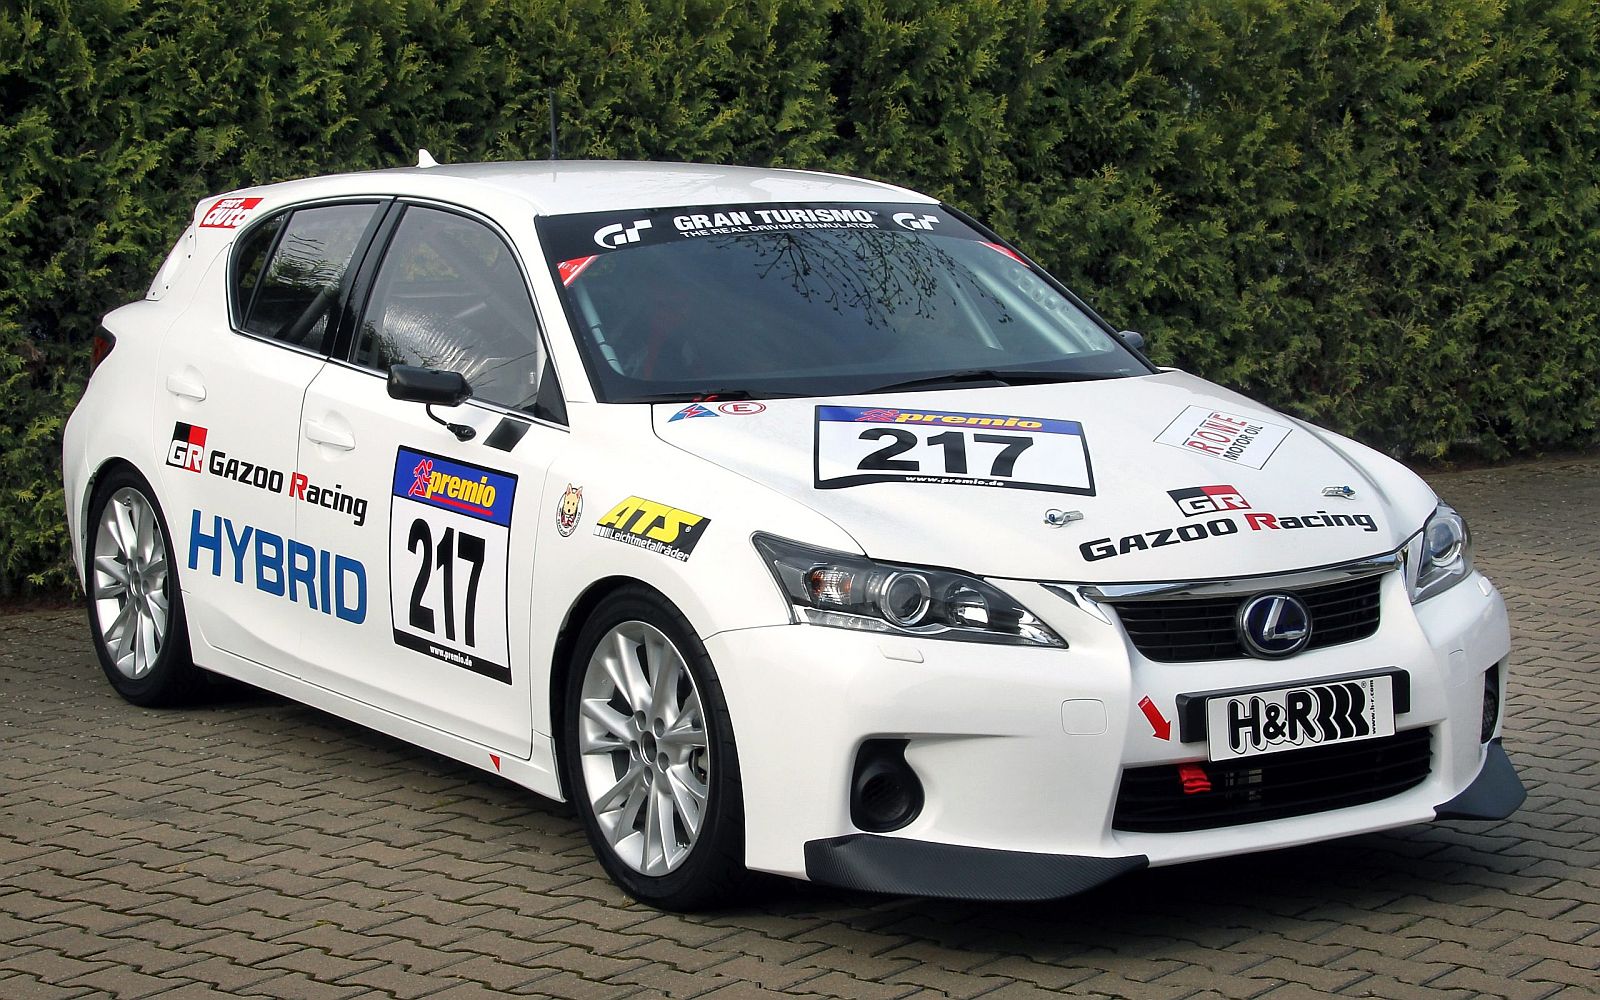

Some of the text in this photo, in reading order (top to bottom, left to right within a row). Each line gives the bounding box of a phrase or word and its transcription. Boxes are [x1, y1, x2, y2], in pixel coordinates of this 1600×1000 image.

[203, 207, 252, 226] auto
[673, 208, 873, 232] GRAN TURISMO
[679, 221, 880, 238] THE REAL DRIVING SIMULATOR
[895, 412, 1043, 429] premio
[1187, 413, 1247, 456] ROWE
[167, 439, 205, 473] GR
[856, 427, 1034, 478] 217
[1222, 424, 1264, 461] MOTOR OIL
[208, 450, 369, 526] GAZOO Racing
[425, 469, 496, 509] premio
[904, 475, 1005, 487] www.premio.de
[597, 495, 704, 544] ATS
[1176, 493, 1251, 517] GR
[610, 528, 690, 562] Leichtmetallräder
[1078, 510, 1379, 562] GAZOO Racing
[188, 508, 368, 625] HYBRID
[407, 517, 486, 649] 217
[429, 645, 473, 667] www.premio.de
